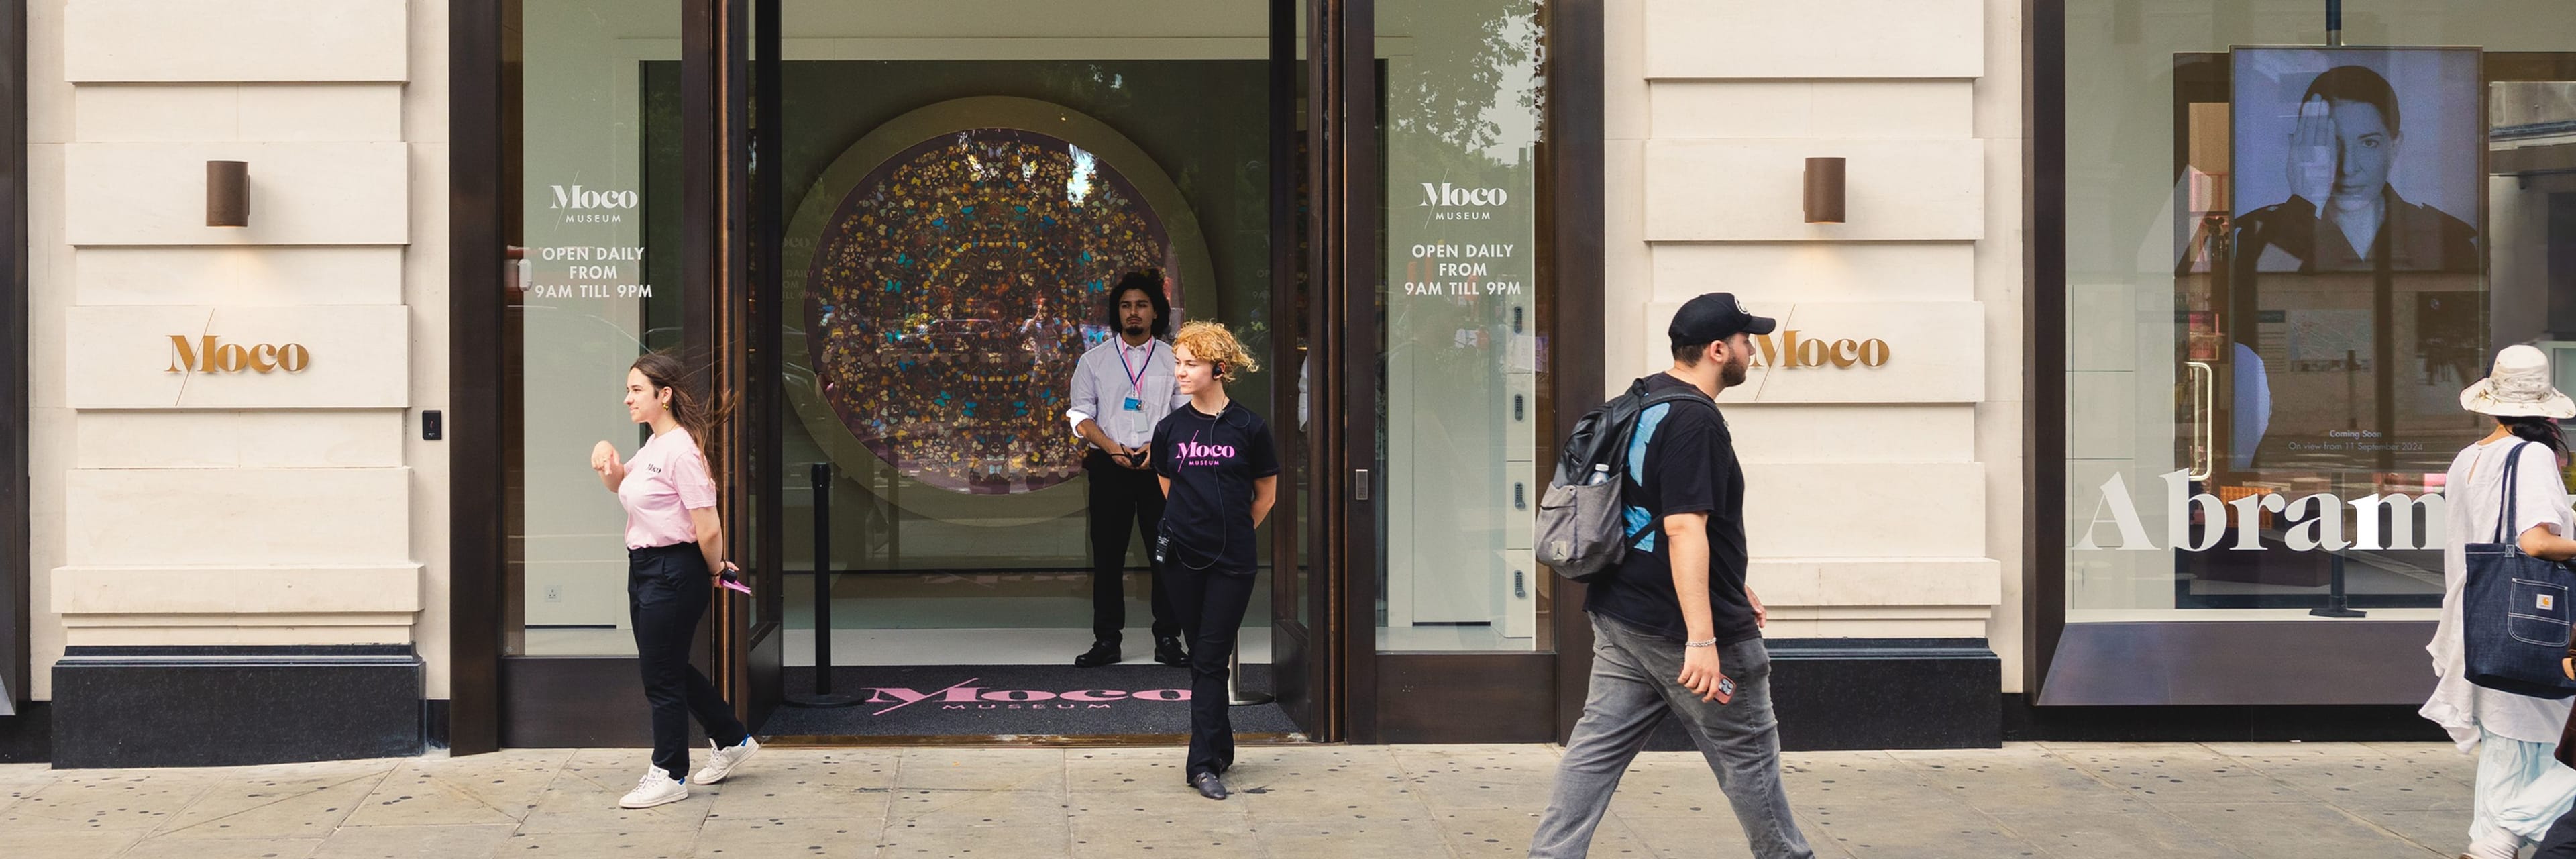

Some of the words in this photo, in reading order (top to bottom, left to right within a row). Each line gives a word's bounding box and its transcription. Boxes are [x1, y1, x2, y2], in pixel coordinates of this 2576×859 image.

[566, 215, 621, 223] MUSEUM
[1436, 212, 1490, 220] MUSEUM
[542, 247, 589, 260] OPEN
[596, 247, 645, 260] DAILY
[1412, 244, 1458, 258] OPEN
[1466, 244, 1513, 258] DAILY
[570, 266, 617, 279] FROM
[1440, 263, 1487, 276] FROM
[535, 285, 572, 298] 9AM
[580, 285, 610, 297] TILL
[617, 285, 652, 298] 9PM
[1405, 282, 1442, 295] 9AM
[1449, 282, 1479, 295] TILL
[1486, 282, 1521, 295] 9PM
[2329, 430, 2360, 440] Coming
[2362, 430, 2382, 438] Soon
[2288, 442, 2301, 450] On
[2304, 442, 2323, 450] view
[2324, 442, 2342, 450] from
[2357, 442, 2400, 452] September
[2402, 442, 2423, 450] 2024
